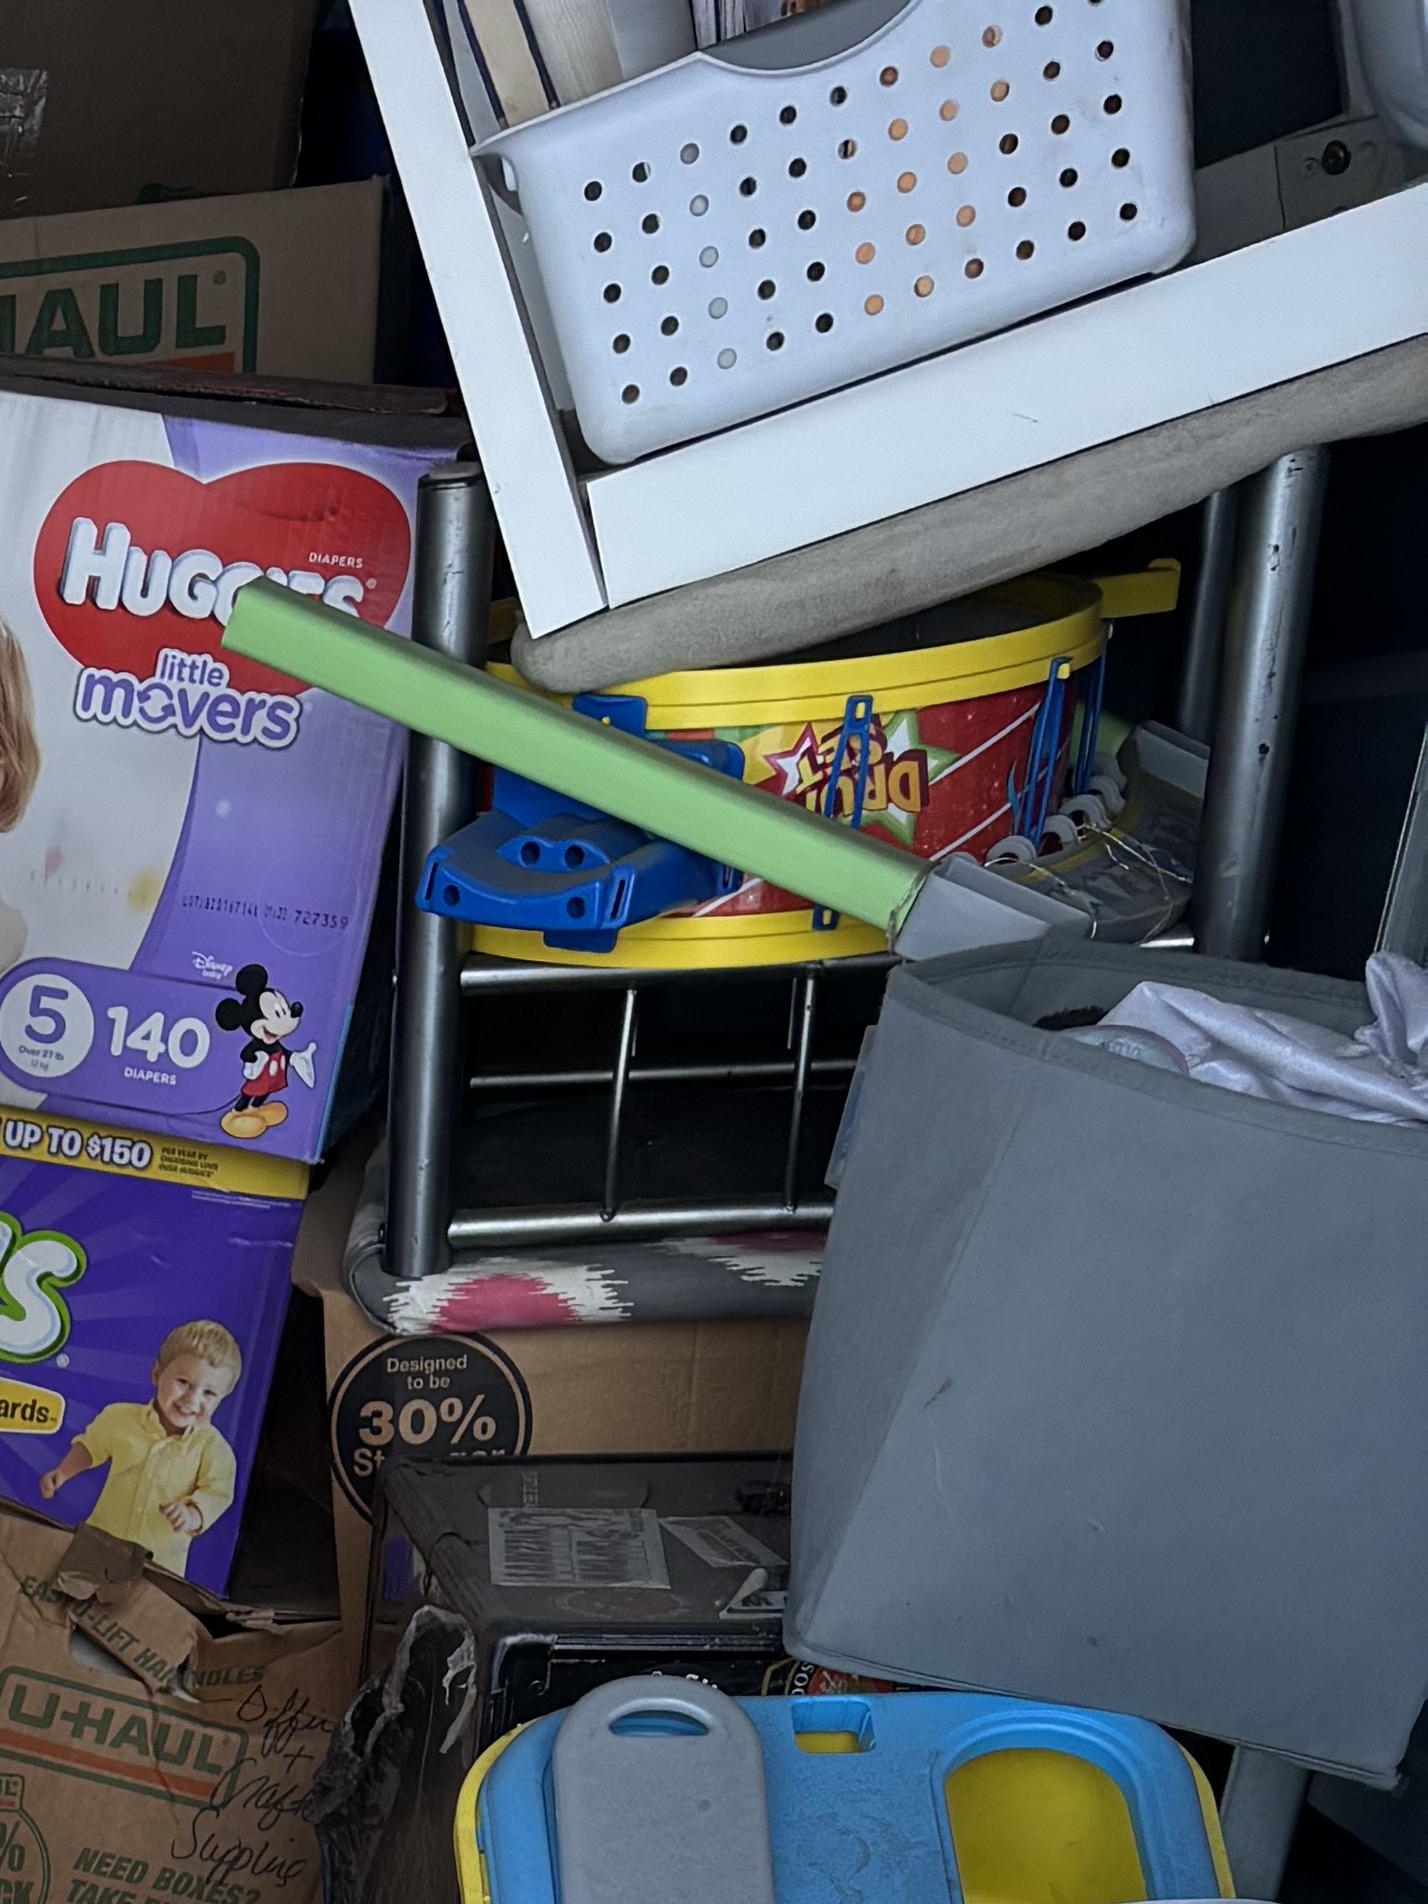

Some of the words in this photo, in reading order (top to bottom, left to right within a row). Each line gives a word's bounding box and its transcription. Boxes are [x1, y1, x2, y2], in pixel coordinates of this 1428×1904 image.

[308, 552, 364, 570] DIAPERS
[160, 654, 226, 690] little
[80, 672, 296, 743] movers
[24, 984, 69, 1044] 5
[107, 1006, 211, 1069] 140
[124, 1066, 177, 1086] DIAPERS
[4, 1120, 40, 1149] UP
[47, 1127, 82, 1157] TO
[86, 1134, 152, 1170] $150
[387, 1355, 468, 1374] Designed
[407, 1376, 423, 1389] to
[429, 1375, 450, 1389] be
[358, 1394, 496, 1446] 30%
[8, 1684, 225, 1776] U-HAUL
[73, 1847, 149, 1884] NEED
